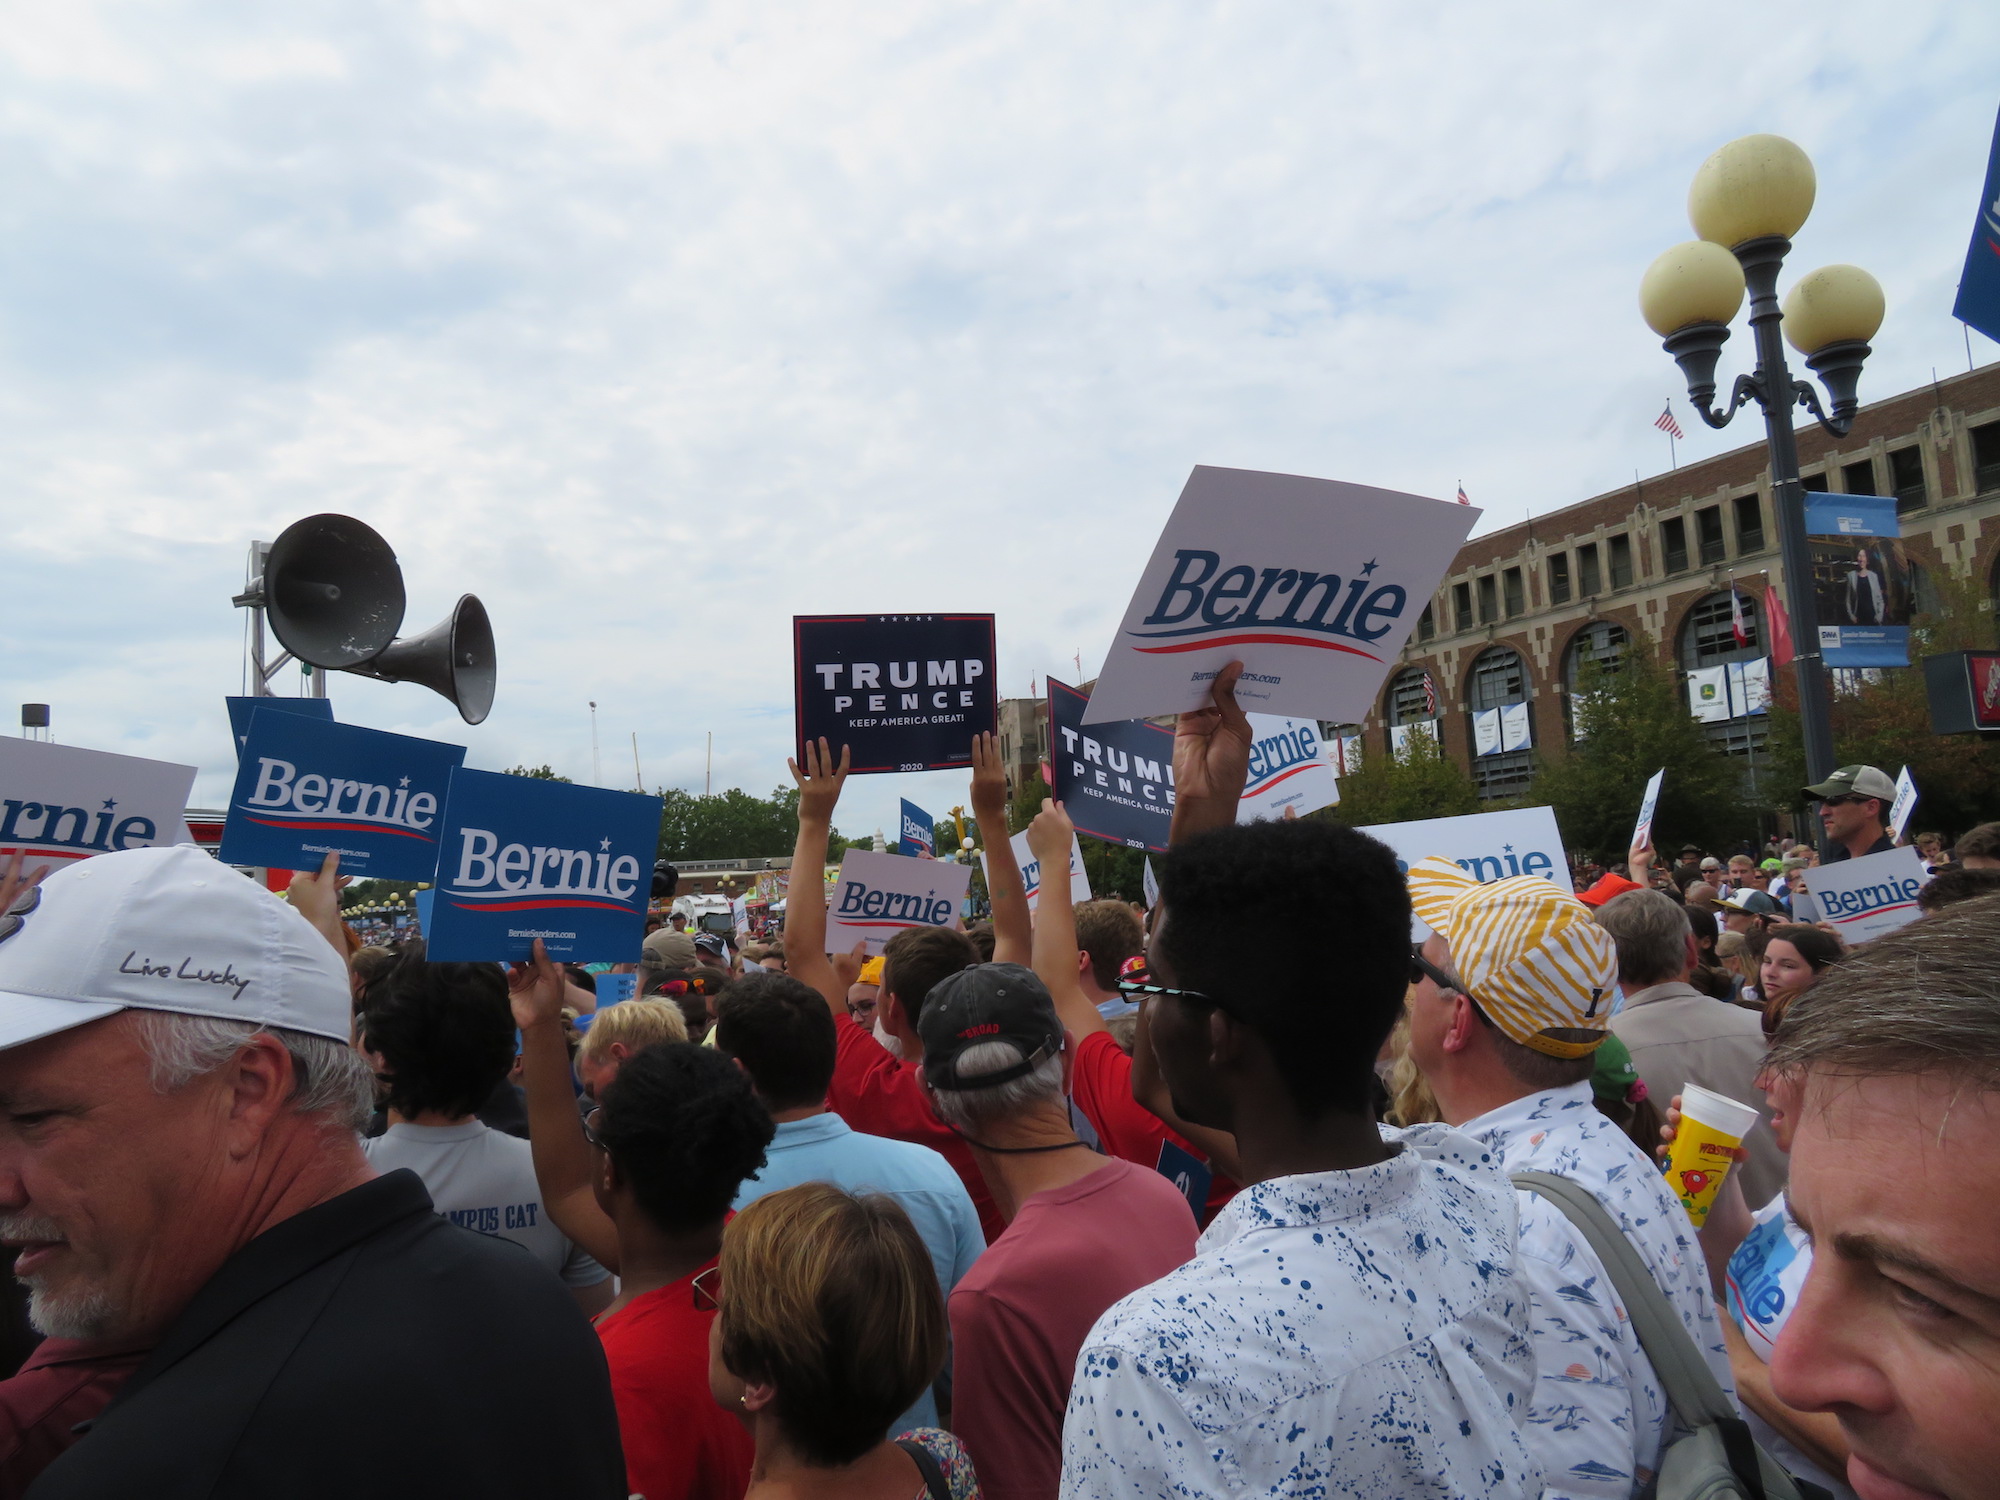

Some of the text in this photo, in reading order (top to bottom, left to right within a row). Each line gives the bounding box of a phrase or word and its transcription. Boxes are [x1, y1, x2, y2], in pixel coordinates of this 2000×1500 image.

[1143, 549, 1406, 640] Bernie
[816, 659, 984, 690] TRUMP
[835, 690, 974, 713] PENCE
[849, 714, 965, 728] KEEP AMERICA GREAT!
[900, 763, 923, 771] 2020
[1248, 726, 1318, 777] ernie
[248, 757, 437, 829] Bernie
[1074, 761, 1176, 805] PENCE
[1083, 786, 1103, 798] KEEP
[1106, 793, 1142, 809] AMERICA
[0, 798, 156, 852] rnie
[903, 815, 932, 847] Bernie
[1126, 839, 1145, 849] 2020
[453, 828, 640, 899] Bernie
[838, 881, 952, 925] Bernie
[1818, 877, 1920, 916] Bernie
[508, 928, 576, 940] BernieSanders.com
[119, 950, 250, 1000] Live Lucky
[966, 1023, 999, 1039] BROAD
[450, 1203, 538, 1231] MPUS CAT
